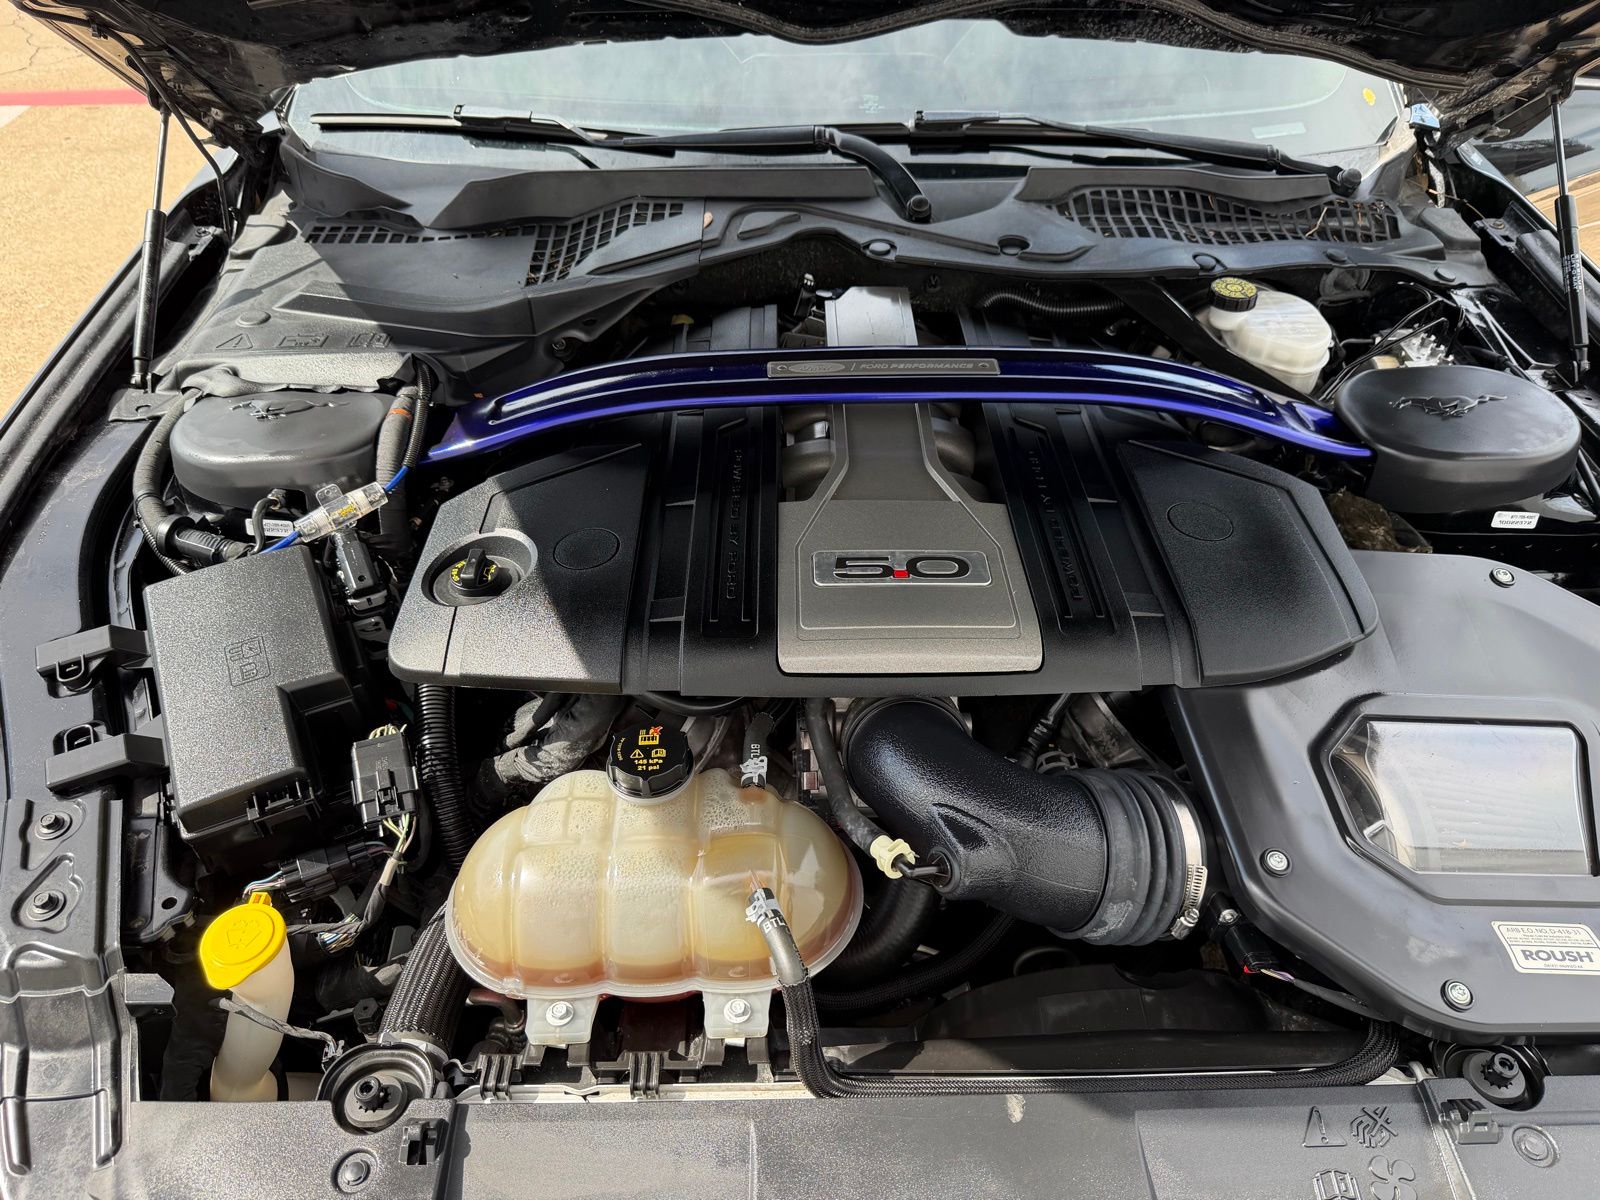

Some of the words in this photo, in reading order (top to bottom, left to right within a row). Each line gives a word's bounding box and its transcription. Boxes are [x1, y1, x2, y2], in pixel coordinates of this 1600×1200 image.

[890, 362, 974, 370] PERFORMANCE
[833, 556, 971, 579] 5.0
[1520, 949, 1595, 963] ROUSH
